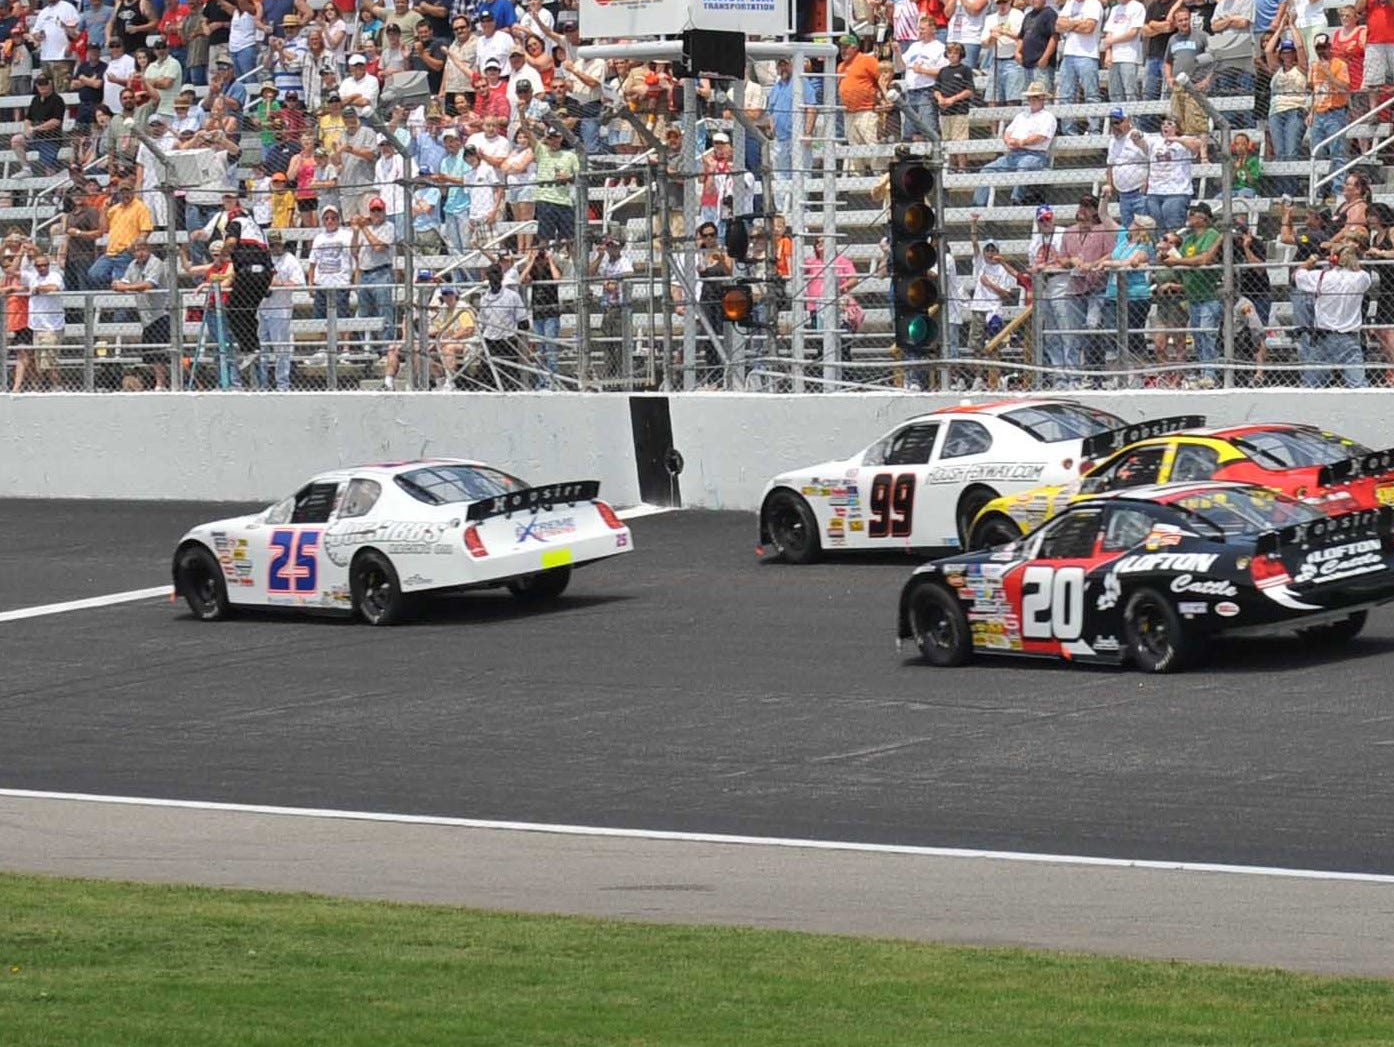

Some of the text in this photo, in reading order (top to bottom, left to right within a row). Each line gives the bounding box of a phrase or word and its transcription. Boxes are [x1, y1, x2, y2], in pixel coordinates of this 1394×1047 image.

[703, 3, 775, 11] TRANSPORTATION
[868, 472, 917, 539] 99
[267, 527, 325, 596] 25
[1169, 573, 1238, 597] Cattle
[1021, 564, 1085, 642] 20
